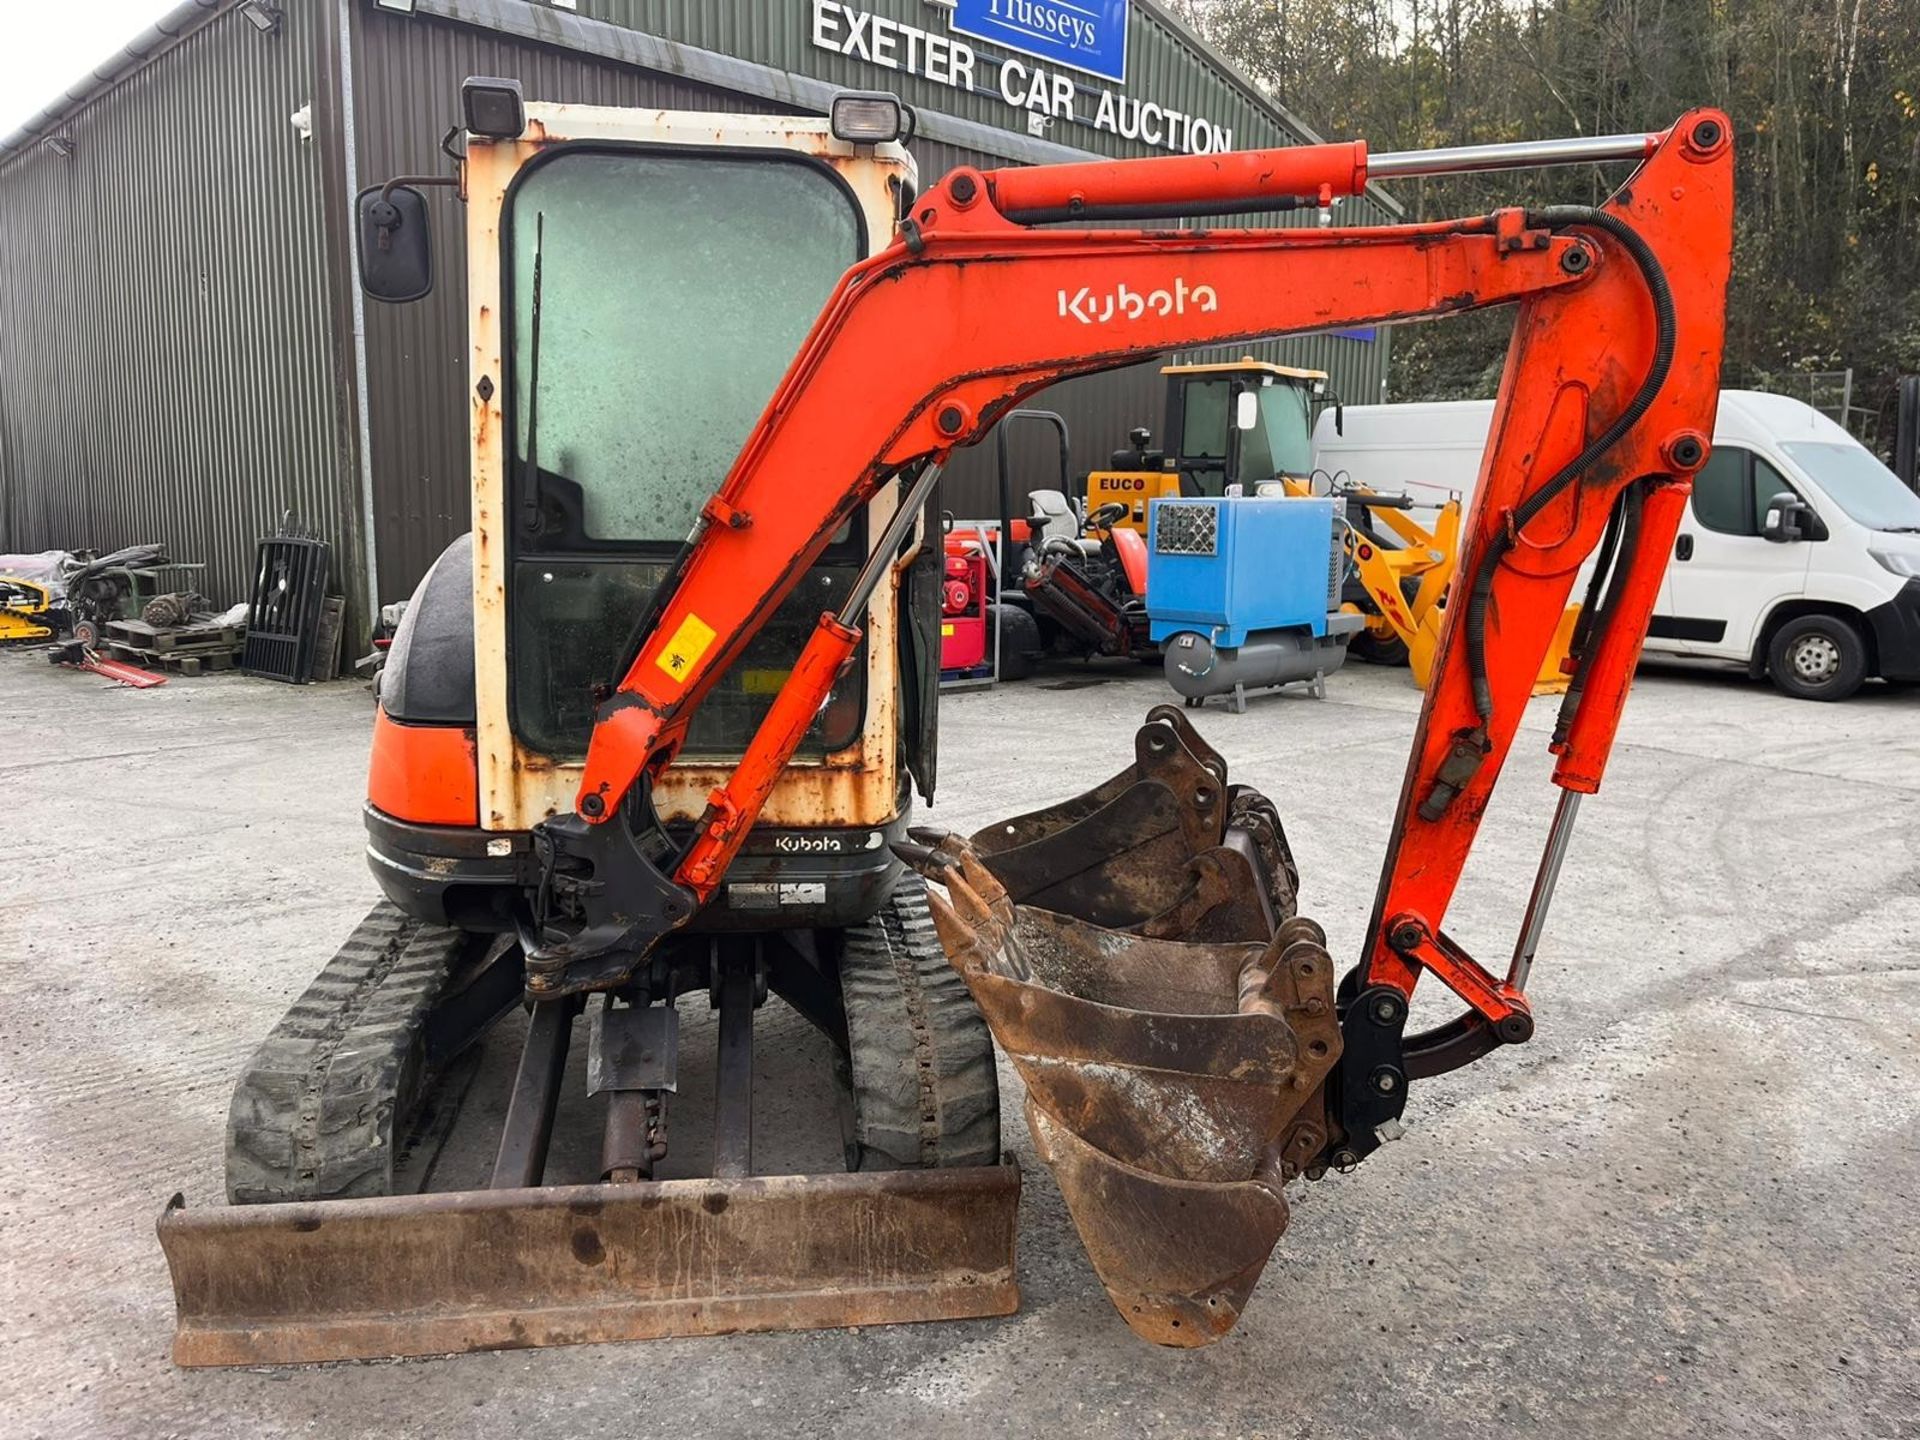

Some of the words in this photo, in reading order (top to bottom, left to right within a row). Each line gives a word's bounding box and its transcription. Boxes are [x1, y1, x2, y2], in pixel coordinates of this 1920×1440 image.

[813, 0, 975, 91] EXETER
[1000, 59, 1075, 121] CAR
[1094, 89, 1232, 155] AUCTION
[1057, 277, 1218, 324] Kubota
[1100, 478, 1145, 491] EUCO
[775, 836, 841, 852] Kubota
